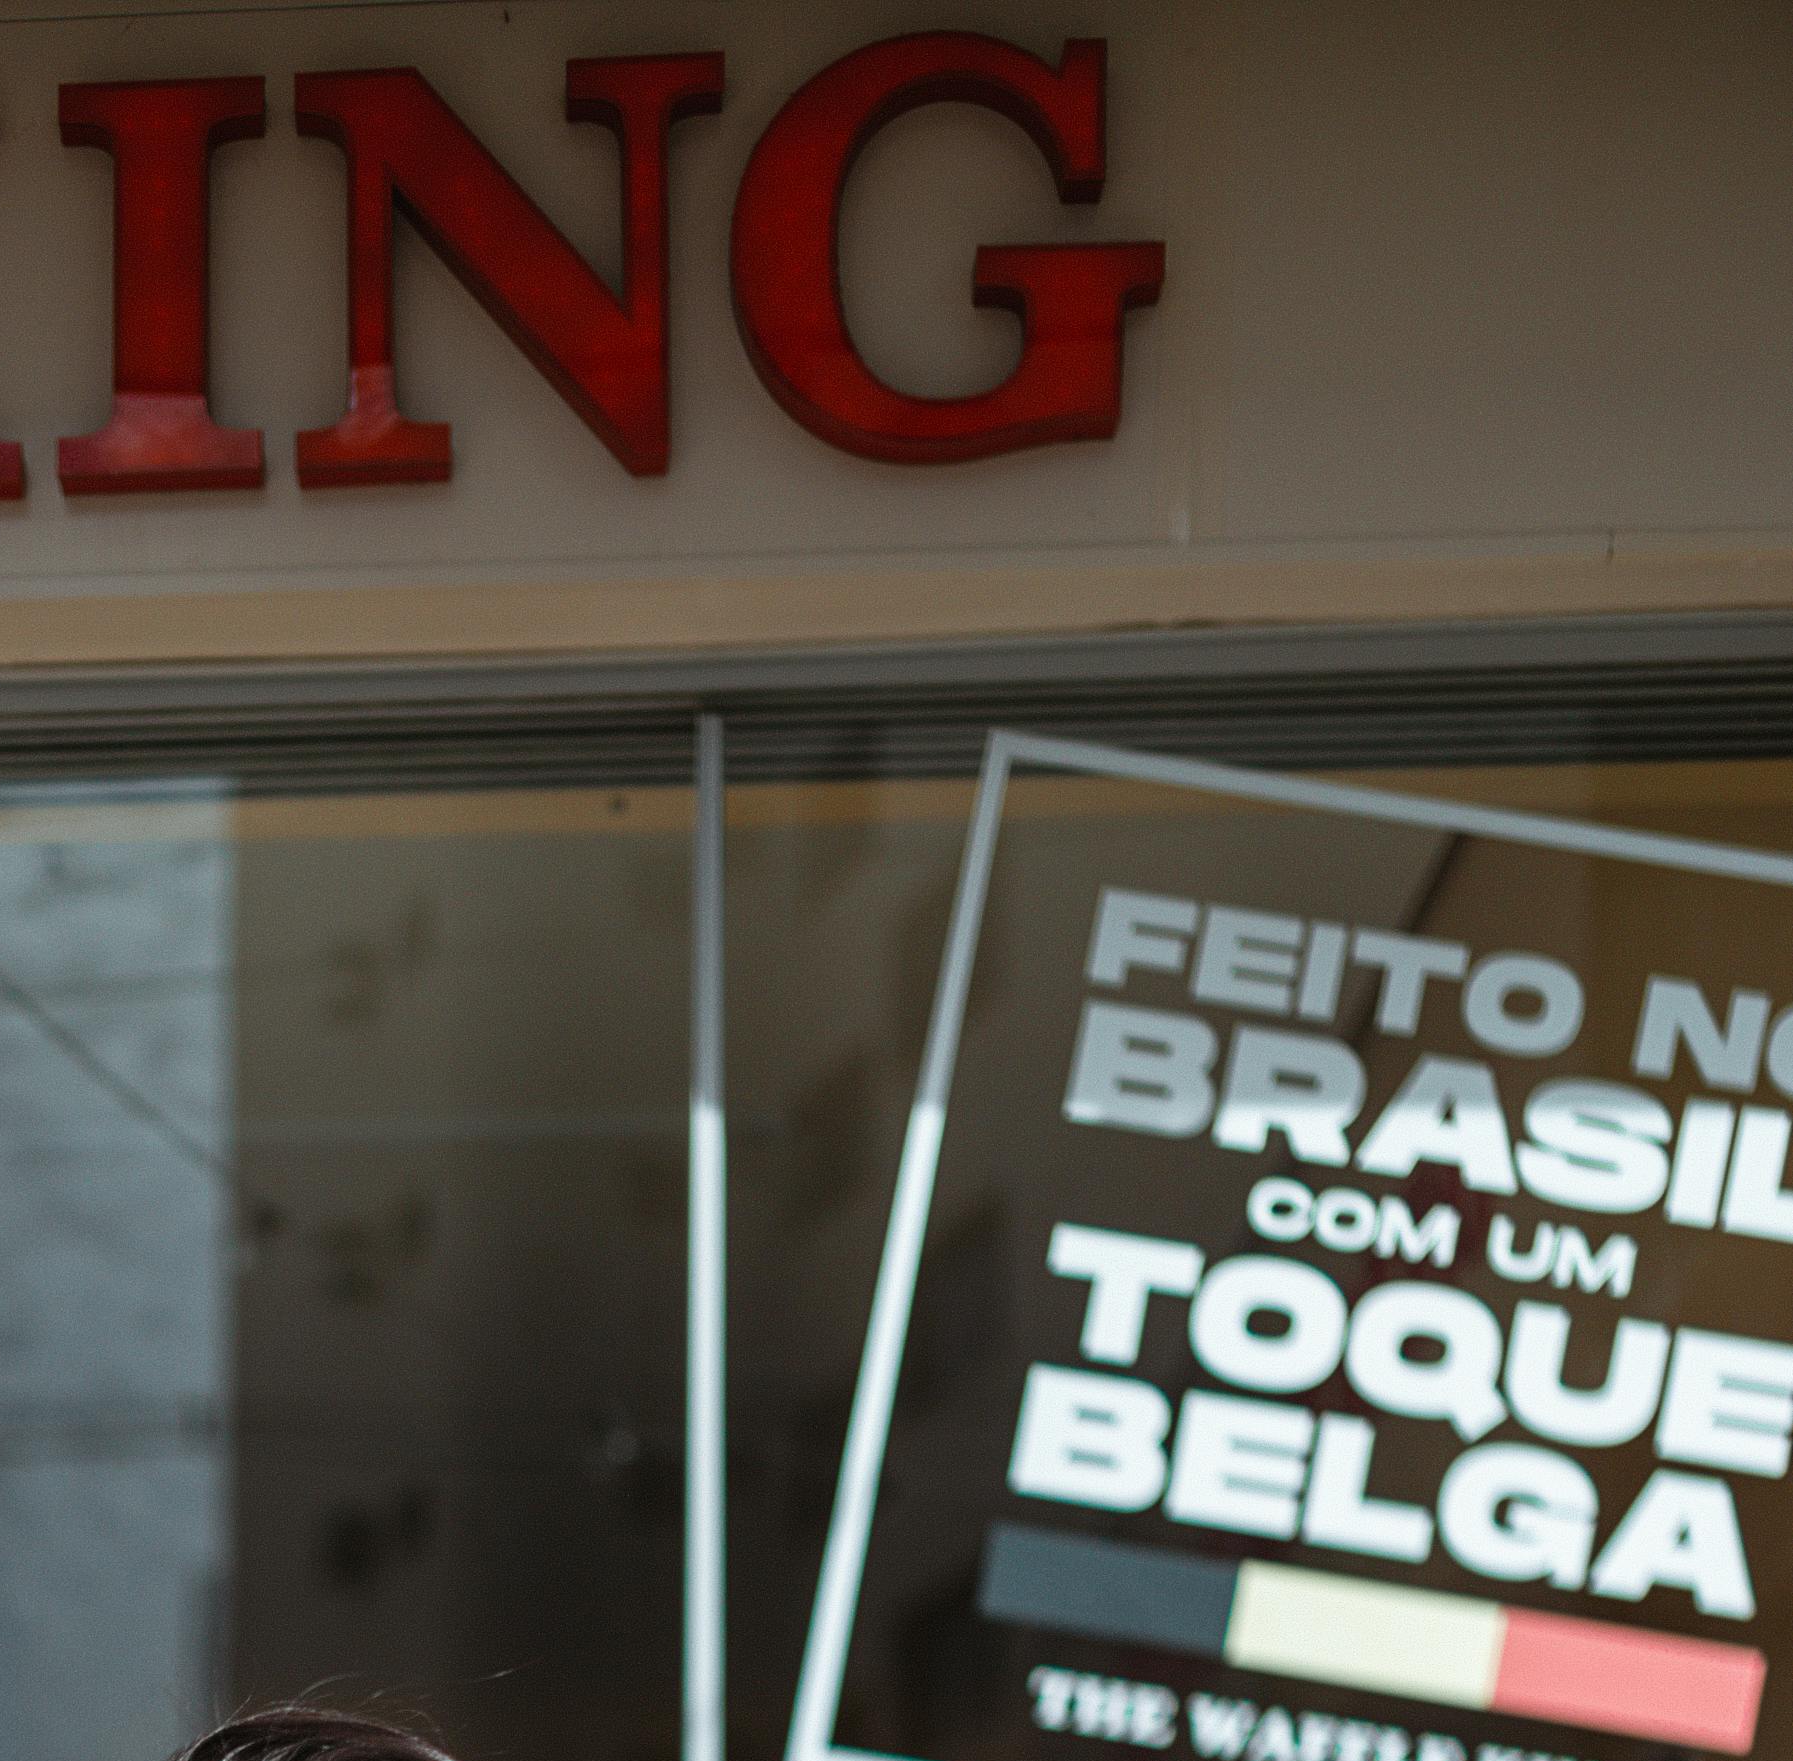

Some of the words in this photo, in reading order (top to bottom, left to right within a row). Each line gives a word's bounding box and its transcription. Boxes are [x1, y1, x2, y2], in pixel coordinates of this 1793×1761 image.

[1085, 886, 1585, 1057] FEITO
[1631, 972, 1793, 1099] N
[1062, 999, 1793, 1244] BRASIL
[1045, 1221, 1793, 1481] TOQUE
[1245, 1175, 1462, 1268] COM
[1485, 1212, 1639, 1300] UM
[1007, 1361, 1756, 1622] BELGA
[1027, 1664, 1179, 1750] THE
